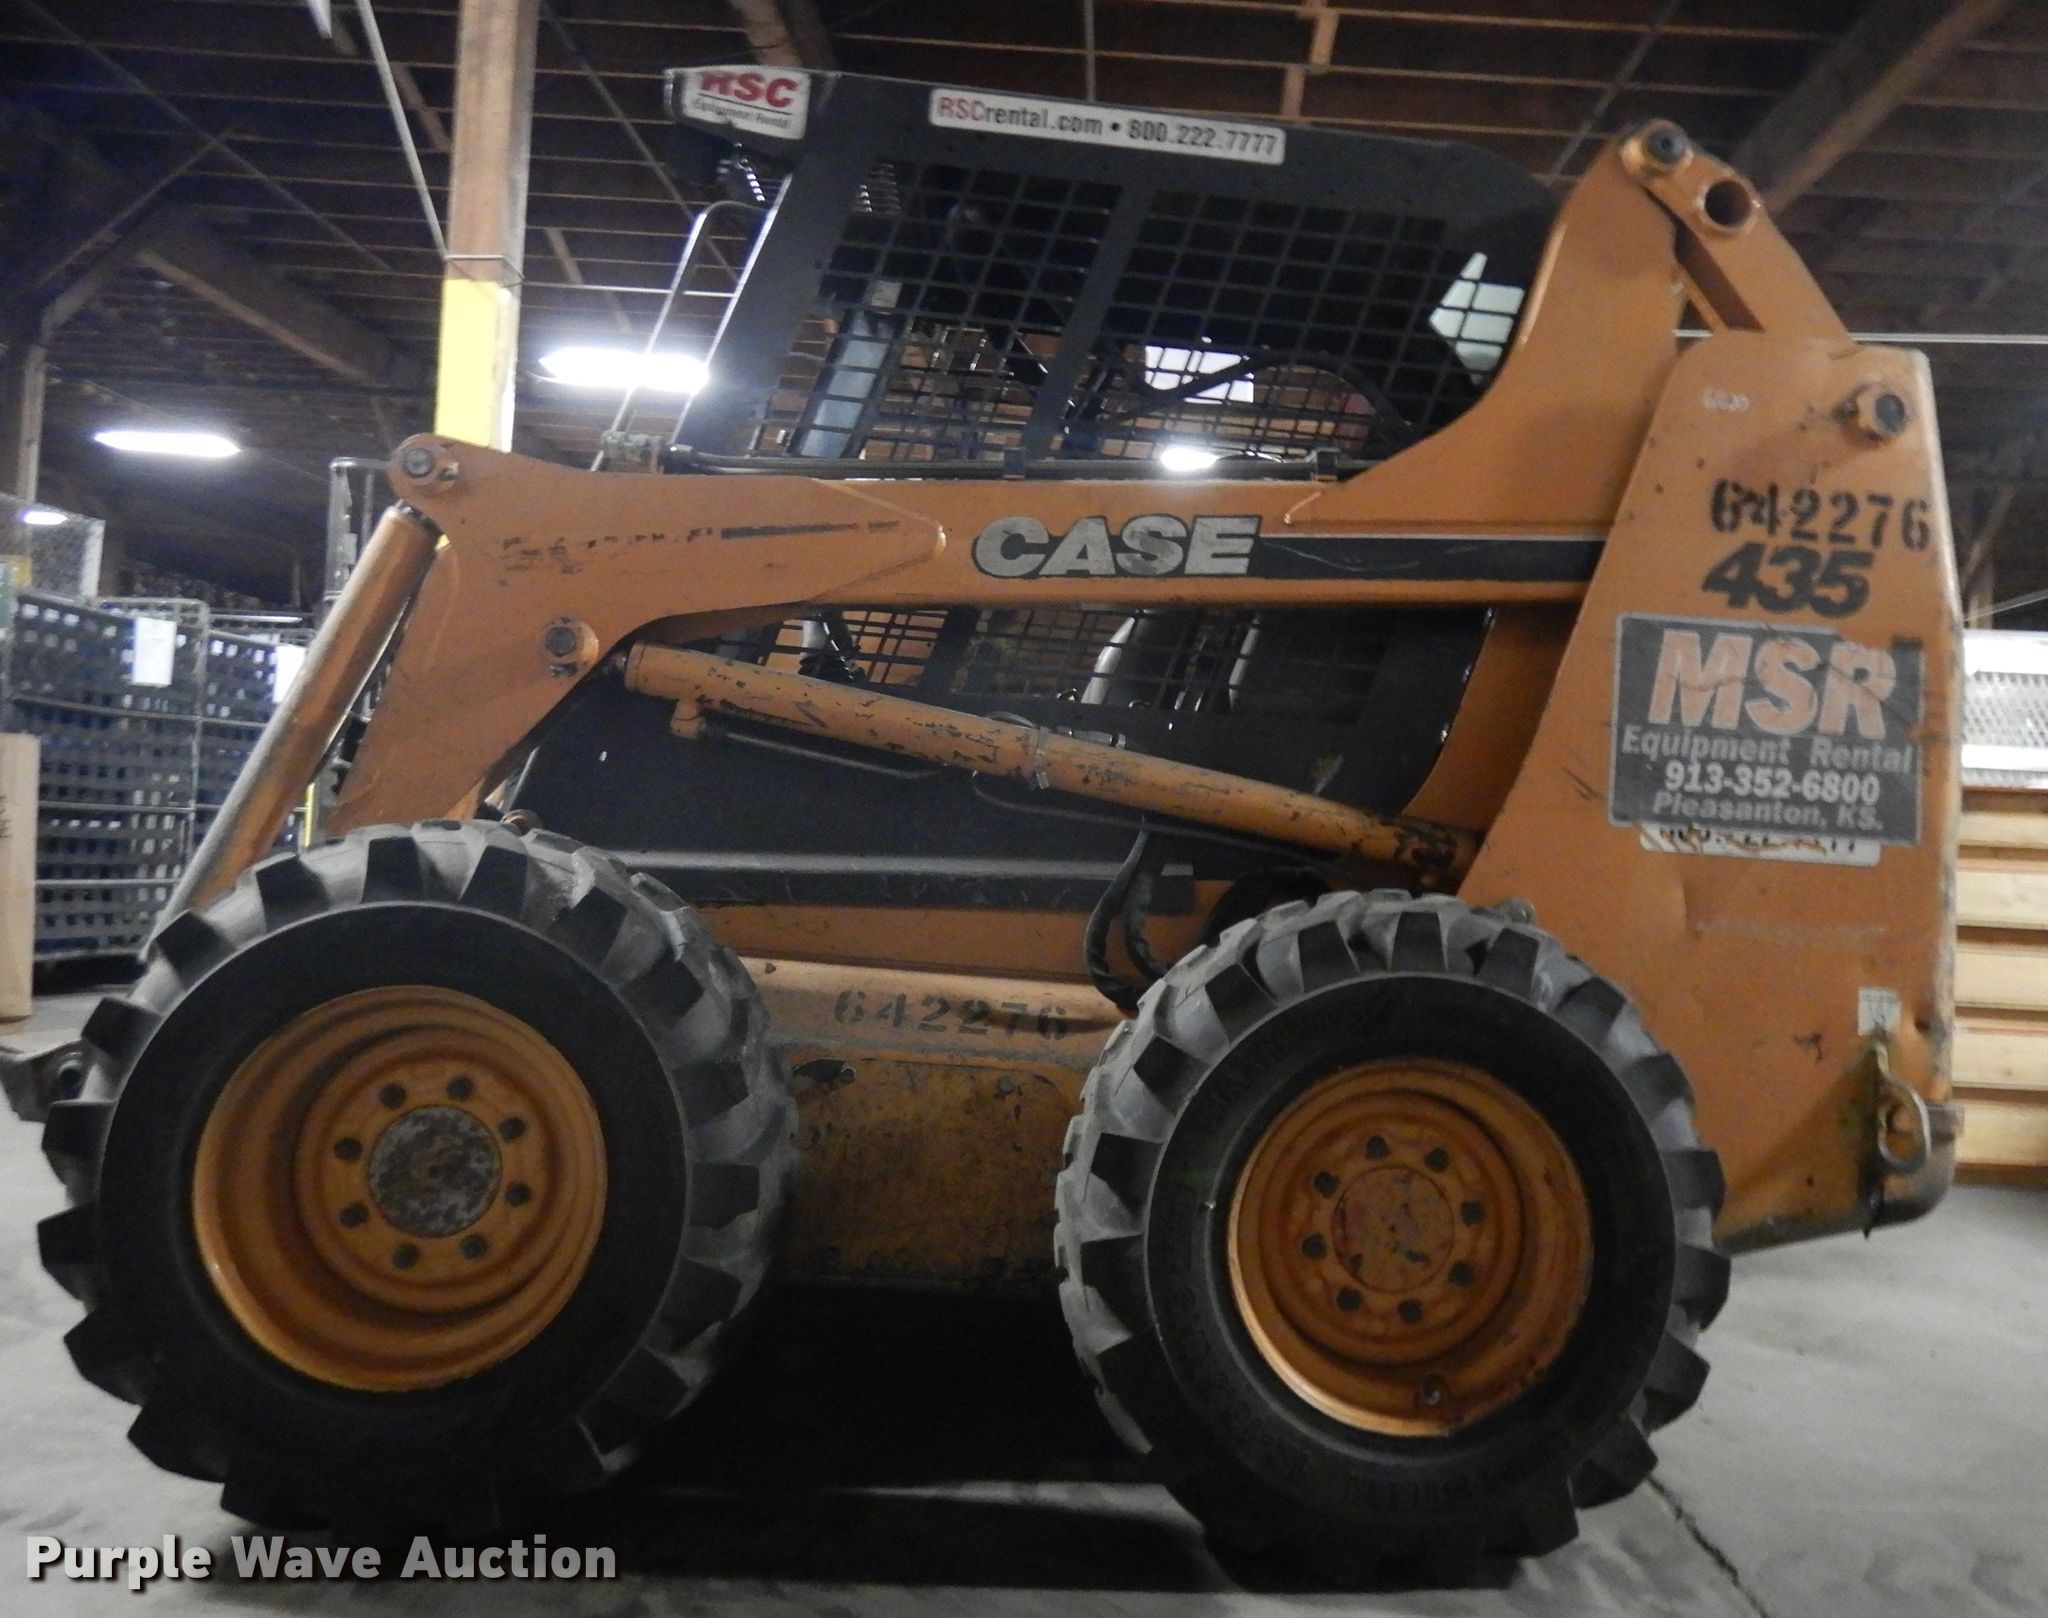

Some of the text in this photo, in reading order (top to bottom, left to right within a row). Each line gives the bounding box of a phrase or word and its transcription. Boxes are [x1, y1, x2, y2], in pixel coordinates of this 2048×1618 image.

[700, 72, 799, 108] RSC
[936, 96, 1278, 155] RSCrental.com 800.222.7777
[1711, 478, 1931, 552] 642276
[973, 513, 1261, 577] CASE
[1702, 542, 1875, 619] 435
[1648, 627, 1898, 741] MSR
[1622, 724, 1914, 775] Equipment Rental
[1653, 789, 1827, 829] Pleasanton,
[1664, 759, 1881, 806] 913-352-6800
[834, 990, 1069, 1041] 642276
